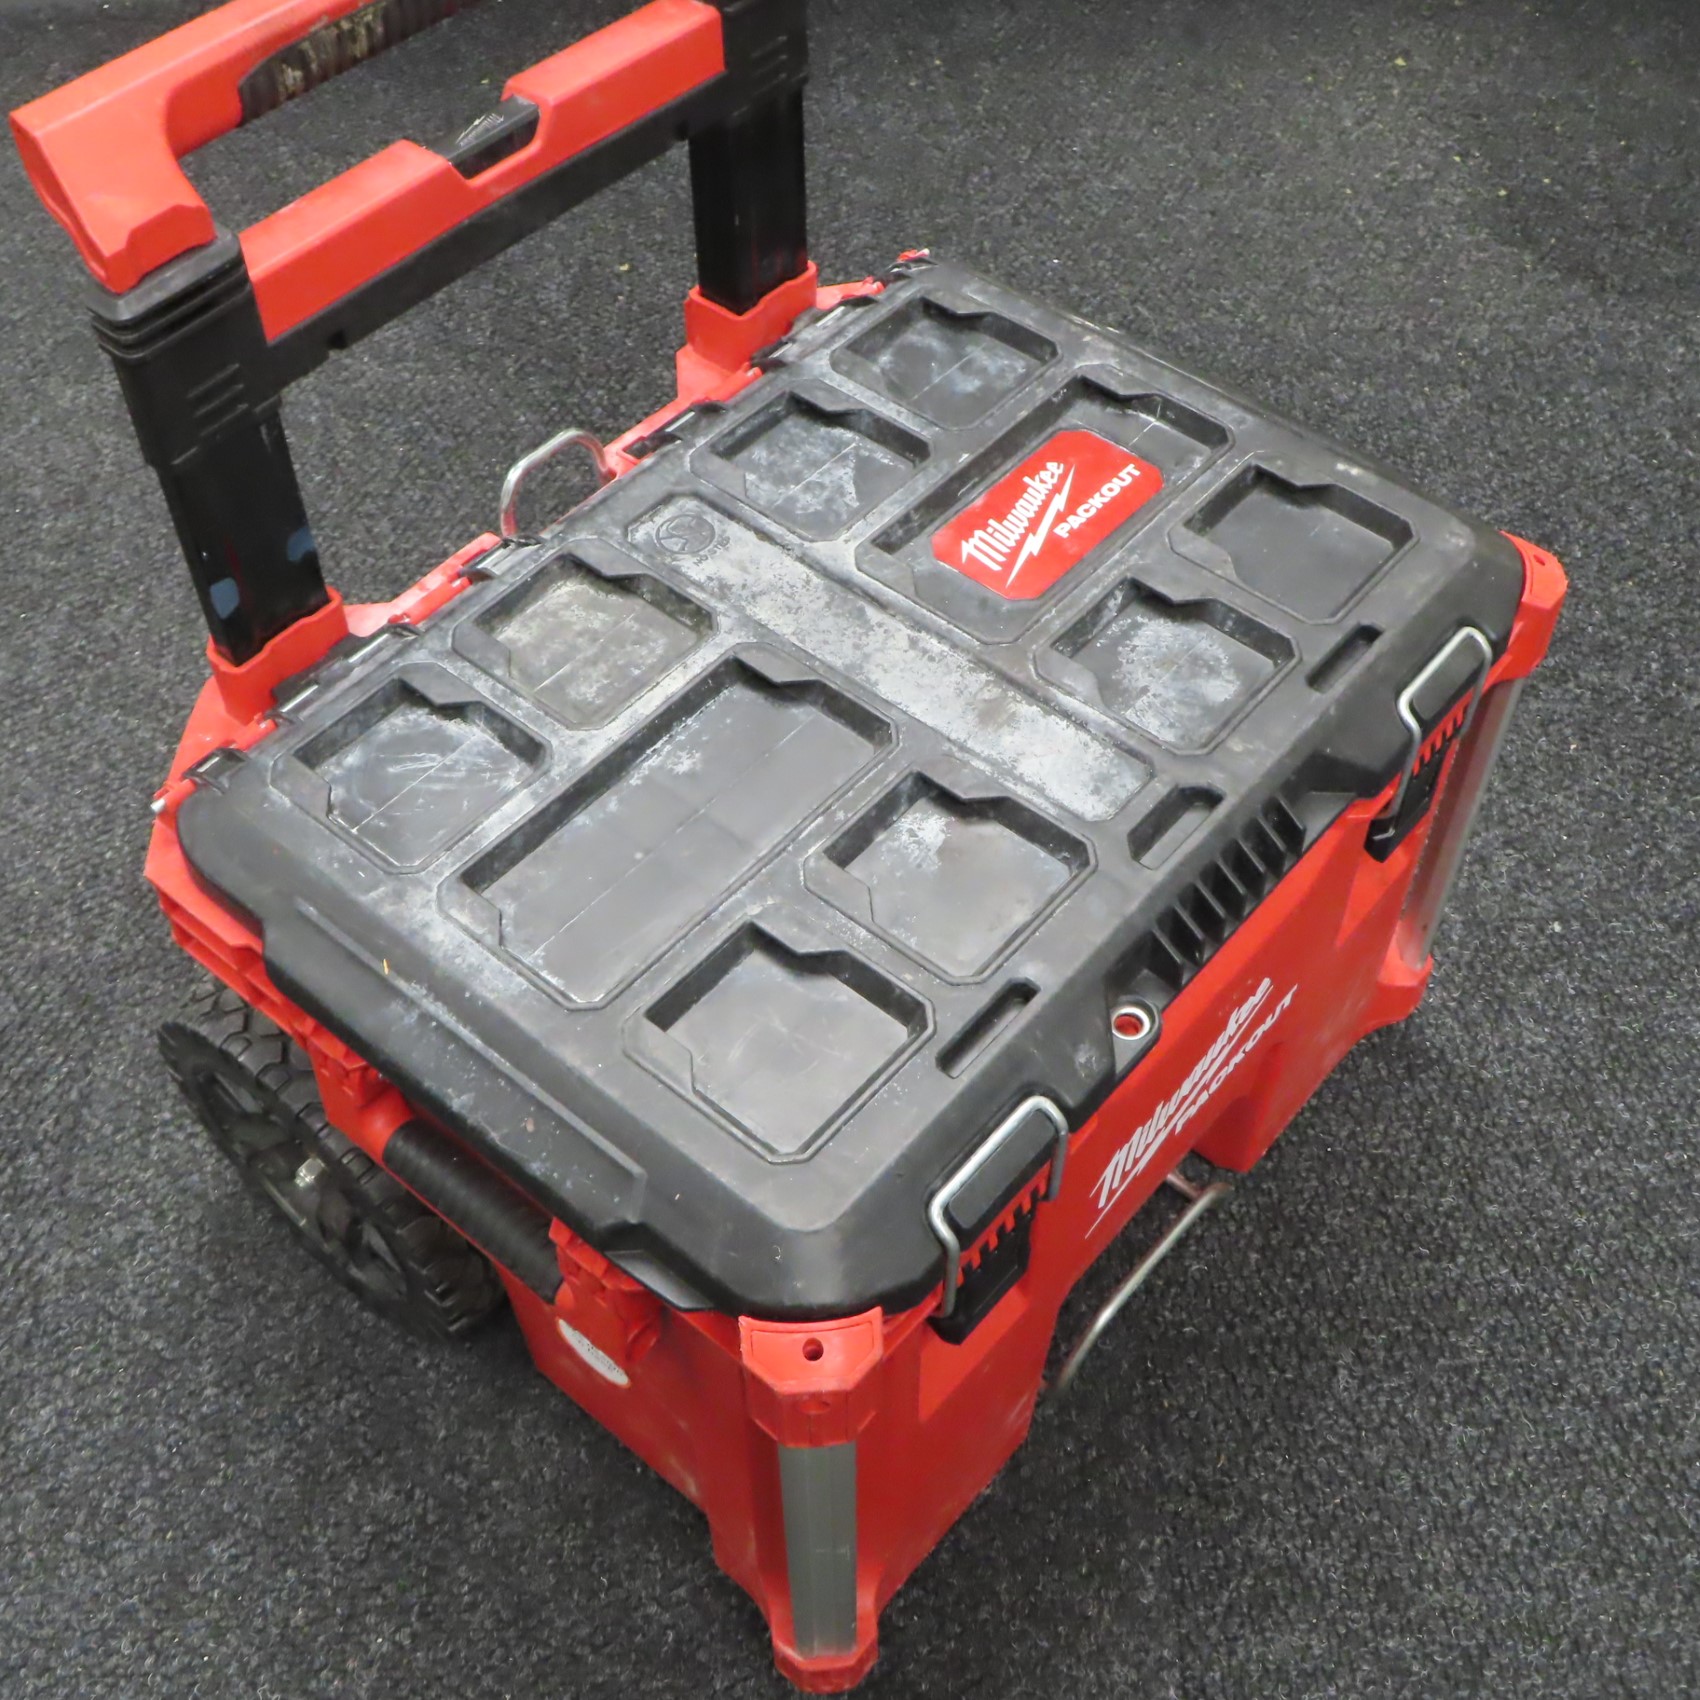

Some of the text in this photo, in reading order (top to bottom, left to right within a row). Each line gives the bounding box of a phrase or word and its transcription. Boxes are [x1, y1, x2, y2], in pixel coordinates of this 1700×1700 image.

[960, 461, 1064, 571] Milwaukee
[1053, 463, 1141, 538] PACKOUT
[1089, 977, 1271, 1209] Milwaukee
[1174, 983, 1298, 1136] PACKOUT
